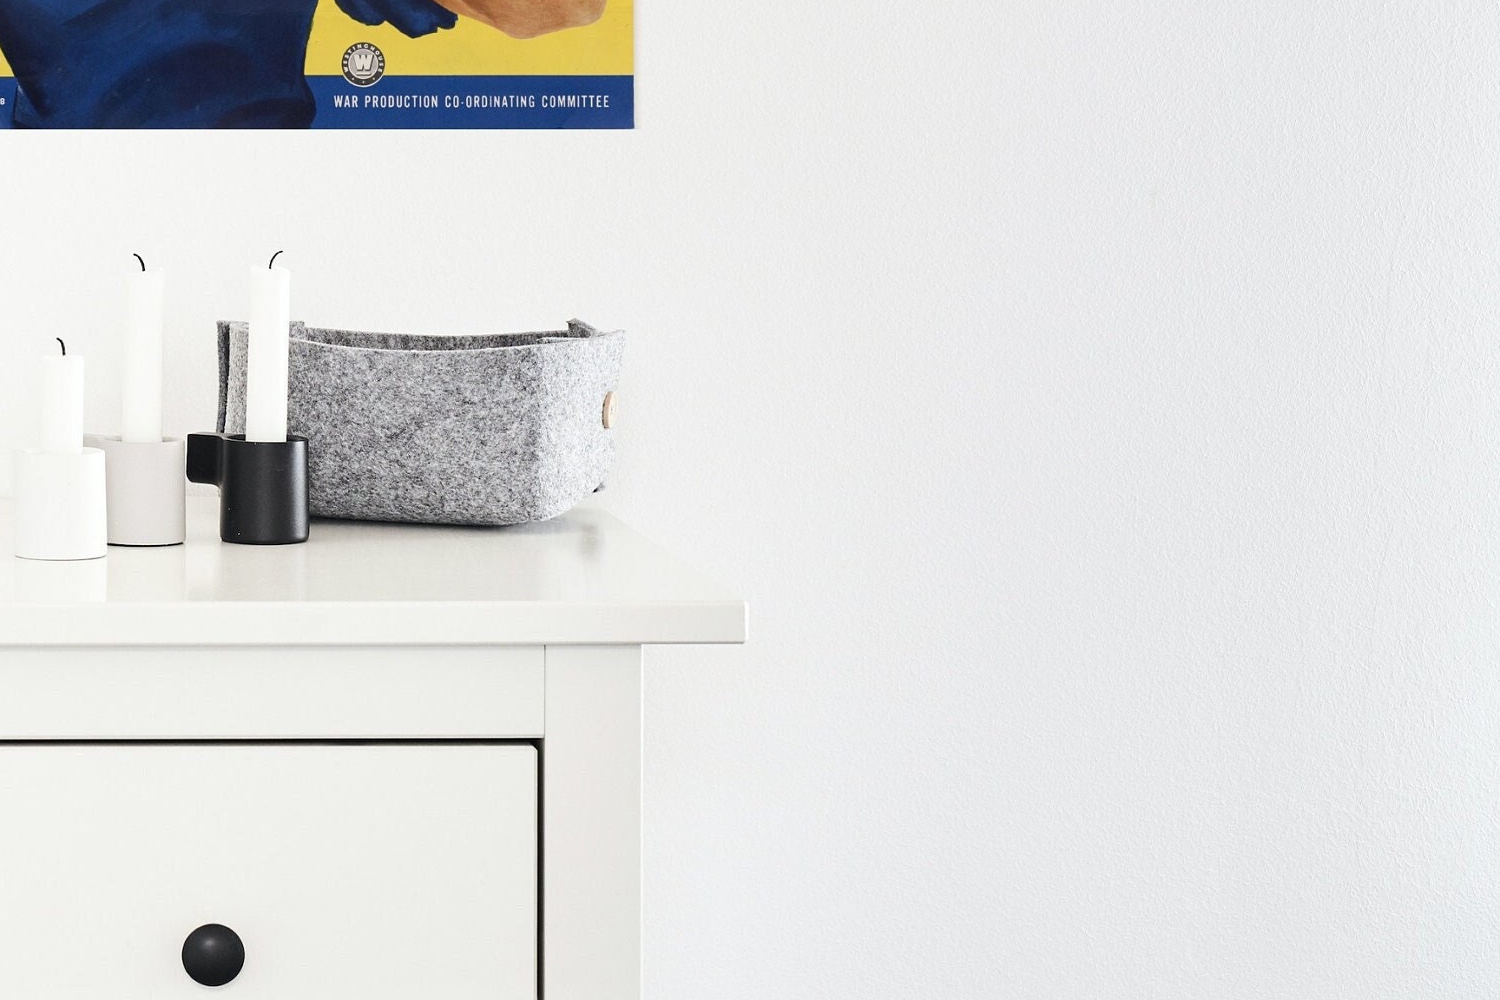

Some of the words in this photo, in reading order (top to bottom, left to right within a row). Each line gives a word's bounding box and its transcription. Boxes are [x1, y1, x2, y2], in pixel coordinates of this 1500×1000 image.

[353, 54, 375, 72] W
[333, 95, 359, 108] WAR
[364, 95, 438, 108] PRODUCTION
[541, 95, 610, 108] COMMITTEE
